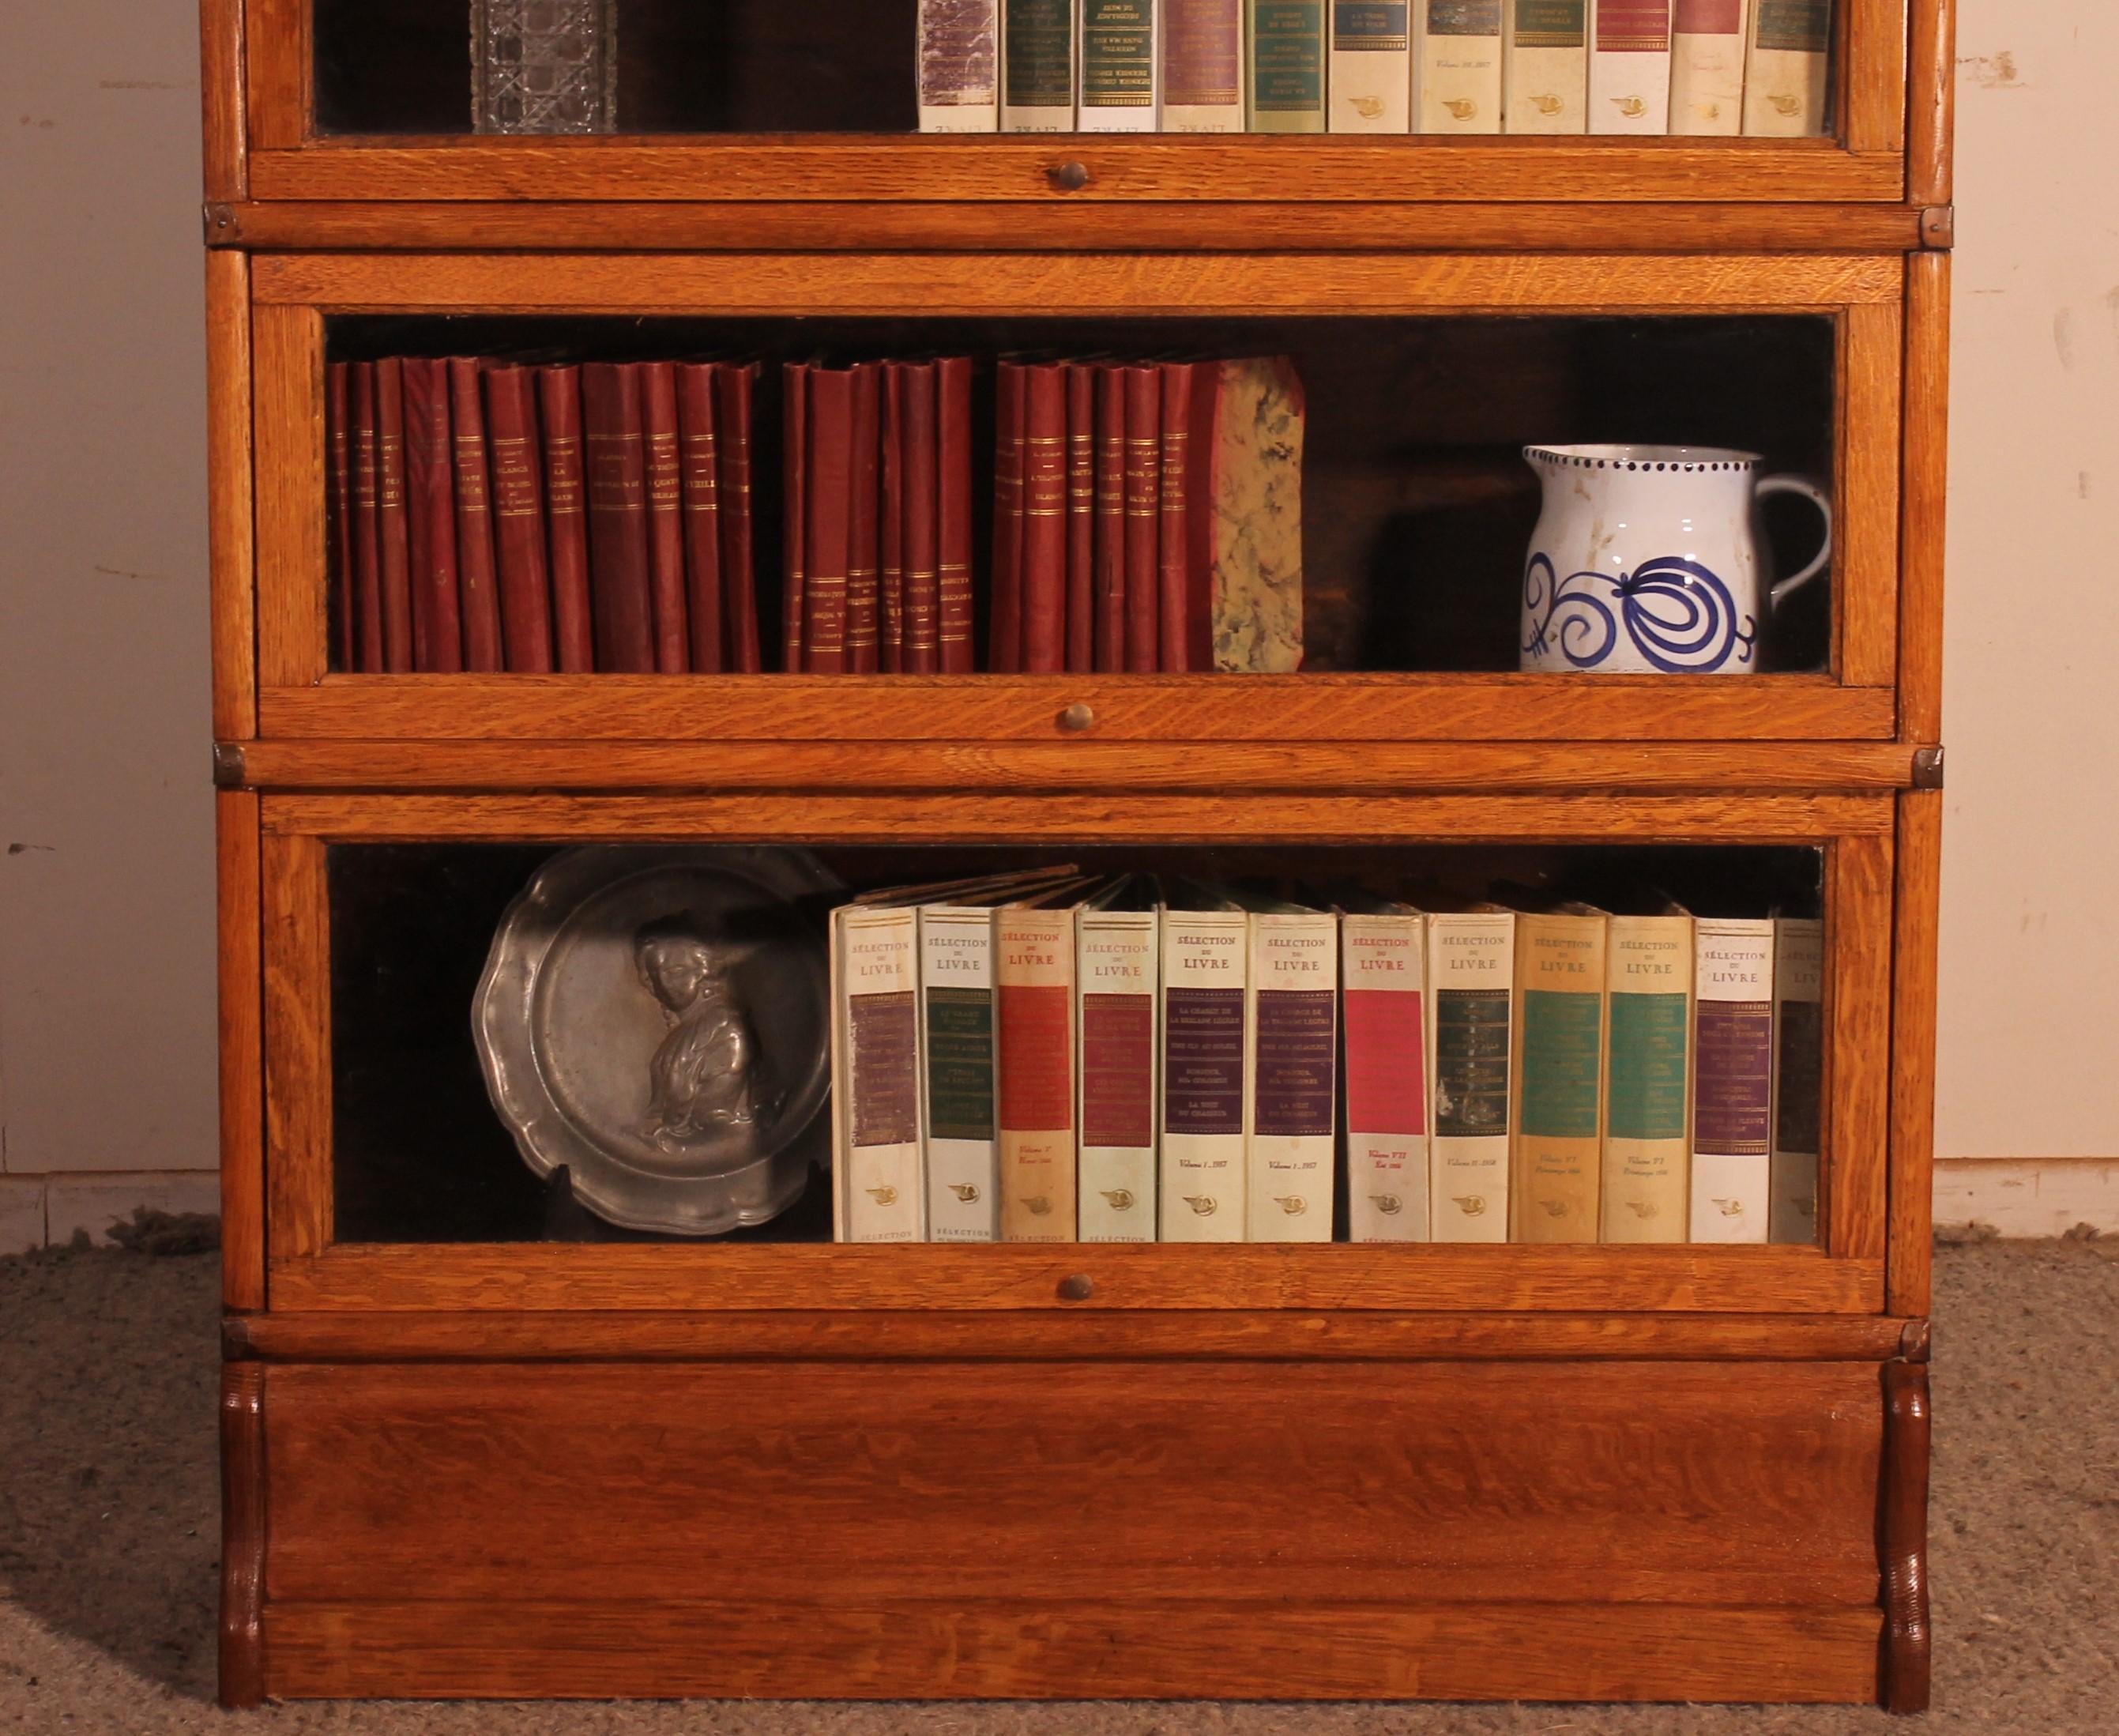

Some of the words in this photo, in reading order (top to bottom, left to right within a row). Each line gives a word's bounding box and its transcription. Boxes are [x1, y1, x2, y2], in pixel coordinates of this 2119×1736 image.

[1000, 932, 1060, 941] SÉLECTION
[1176, 936, 1236, 946] SÉLECTION
[1352, 937, 1410, 947] SÉLECTION
[1441, 936, 1506, 946] SÉLECTION
[852, 941, 909, 953] SÉLECTION
[928, 937, 988, 948] SÉLECTION
[1085, 943, 1150, 953] SÉLECTION
[1267, 938, 1327, 947] SÉLECTION
[1619, 940, 1680, 950] SÉLECTION
[1009, 955, 1055, 966] LIVRE
[1704, 951, 1766, 961] SÉLECTION
[860, 963, 904, 976] LIVRE
[936, 959, 980, 971] LIVRE
[1184, 958, 1229, 970] LIVRE
[1274, 960, 1320, 971] LIVRE
[1361, 960, 1405, 971] LIVRE
[1450, 959, 1497, 970] LIVRE
[1540, 962, 1586, 973] LIVRE
[1626, 963, 1673, 974] LIVRE
[1095, 966, 1142, 977] LIVRE
[1712, 973, 1758, 983] LIVRE
[1180, 1159, 1202, 1168] Volume
[1269, 1161, 1291, 1169] Volume
